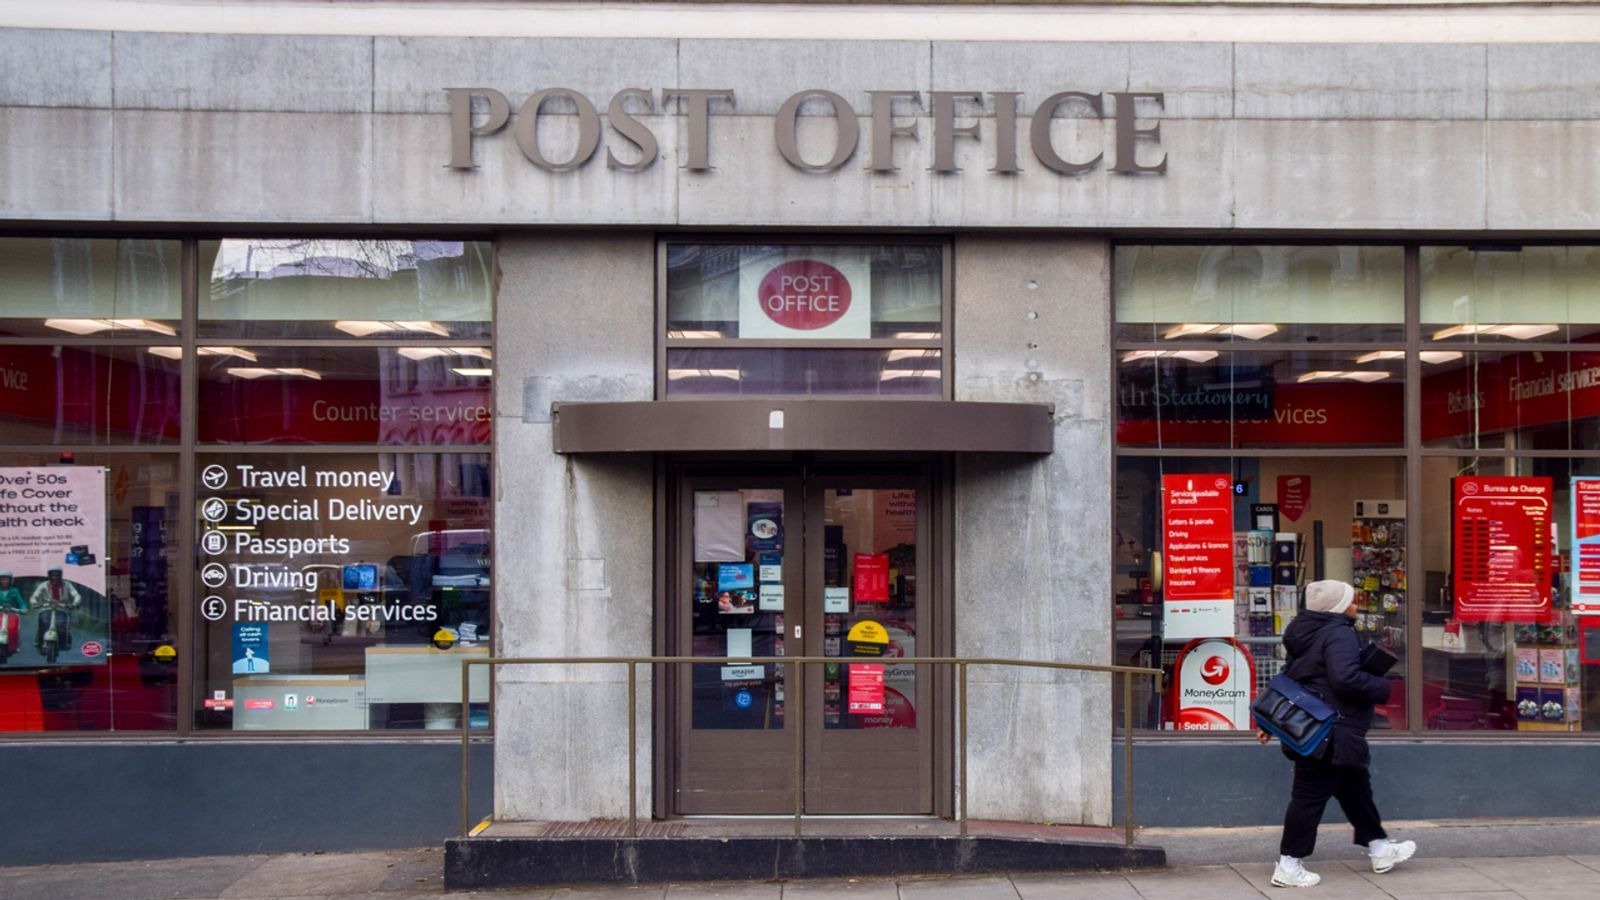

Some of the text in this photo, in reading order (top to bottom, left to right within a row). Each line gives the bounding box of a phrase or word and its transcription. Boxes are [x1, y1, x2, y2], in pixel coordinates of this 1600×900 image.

[442, 87, 1168, 176] POST OFFICE
[781, 275, 832, 292] POST
[768, 295, 840, 312] OFFICE
[1508, 361, 1600, 402] Financial service
[1151, 384, 1269, 409] Stationery
[312, 400, 400, 422] Counter
[36, 474, 67, 485] 50s
[236, 465, 395, 492] Travel money
[21, 488, 72, 499] Cover
[1235, 483, 1244, 494] 6
[1483, 484, 1508, 492] Bureau
[1520, 484, 1546, 494] Change
[49, 502, 78, 512] the
[1178, 497, 1198, 505] branch
[236, 499, 319, 524] Special
[329, 499, 423, 525] Delivery
[31, 516, 84, 526] check
[235, 532, 350, 557] Passports
[234, 566, 318, 592] Driving
[234, 600, 437, 621] Financial services
[1184, 689, 1246, 699] MoneyGram
[1184, 721, 1208, 730] Send
